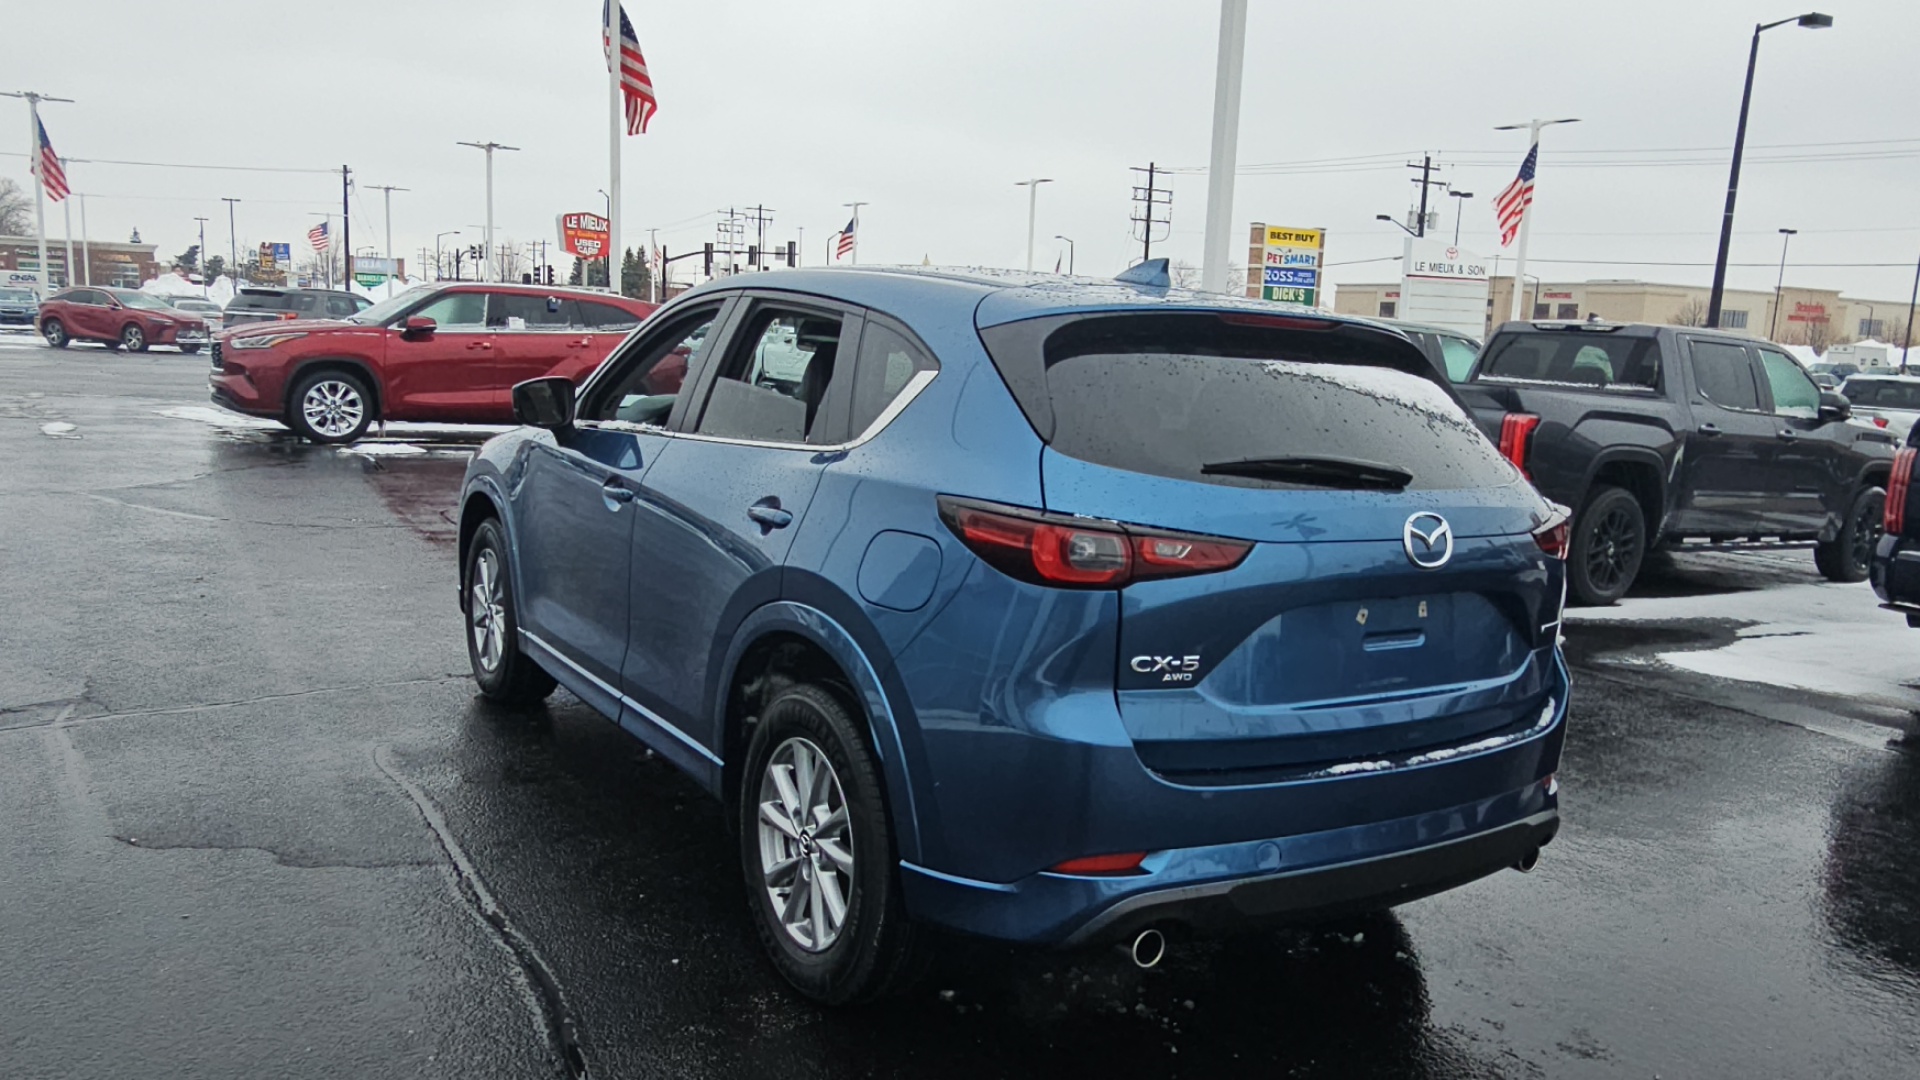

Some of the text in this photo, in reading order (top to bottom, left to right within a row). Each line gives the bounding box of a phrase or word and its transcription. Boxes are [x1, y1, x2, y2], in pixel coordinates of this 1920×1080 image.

[566, 215, 608, 232] LE MIEUX
[574, 238, 601, 248] USED
[1270, 231, 1315, 243] BEST BUY
[1414, 261, 1486, 276] LE MIEUX & SON
[1264, 270, 1294, 282] ROSS
[1272, 287, 1305, 301] DICK'S
[1130, 655, 1201, 673] CX-5
[1162, 673, 1193, 682] AWD
